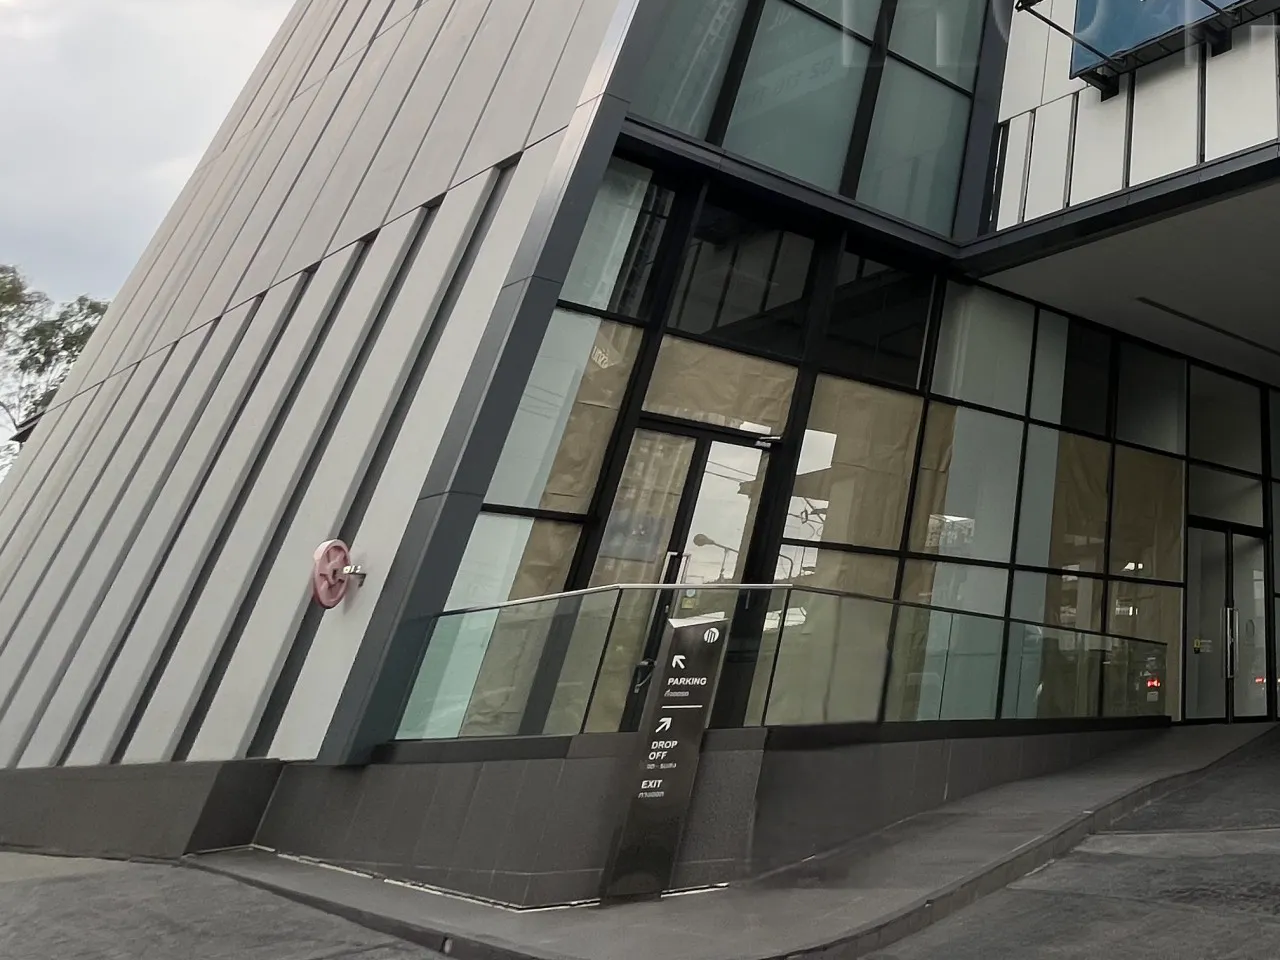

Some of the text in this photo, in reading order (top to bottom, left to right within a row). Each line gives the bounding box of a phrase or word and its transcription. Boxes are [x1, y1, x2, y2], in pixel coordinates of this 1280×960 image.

[667, 677, 707, 686] PARKING
[651, 740, 678, 749] DROP
[648, 751, 667, 760] OFF
[641, 779, 662, 789] EXIT
